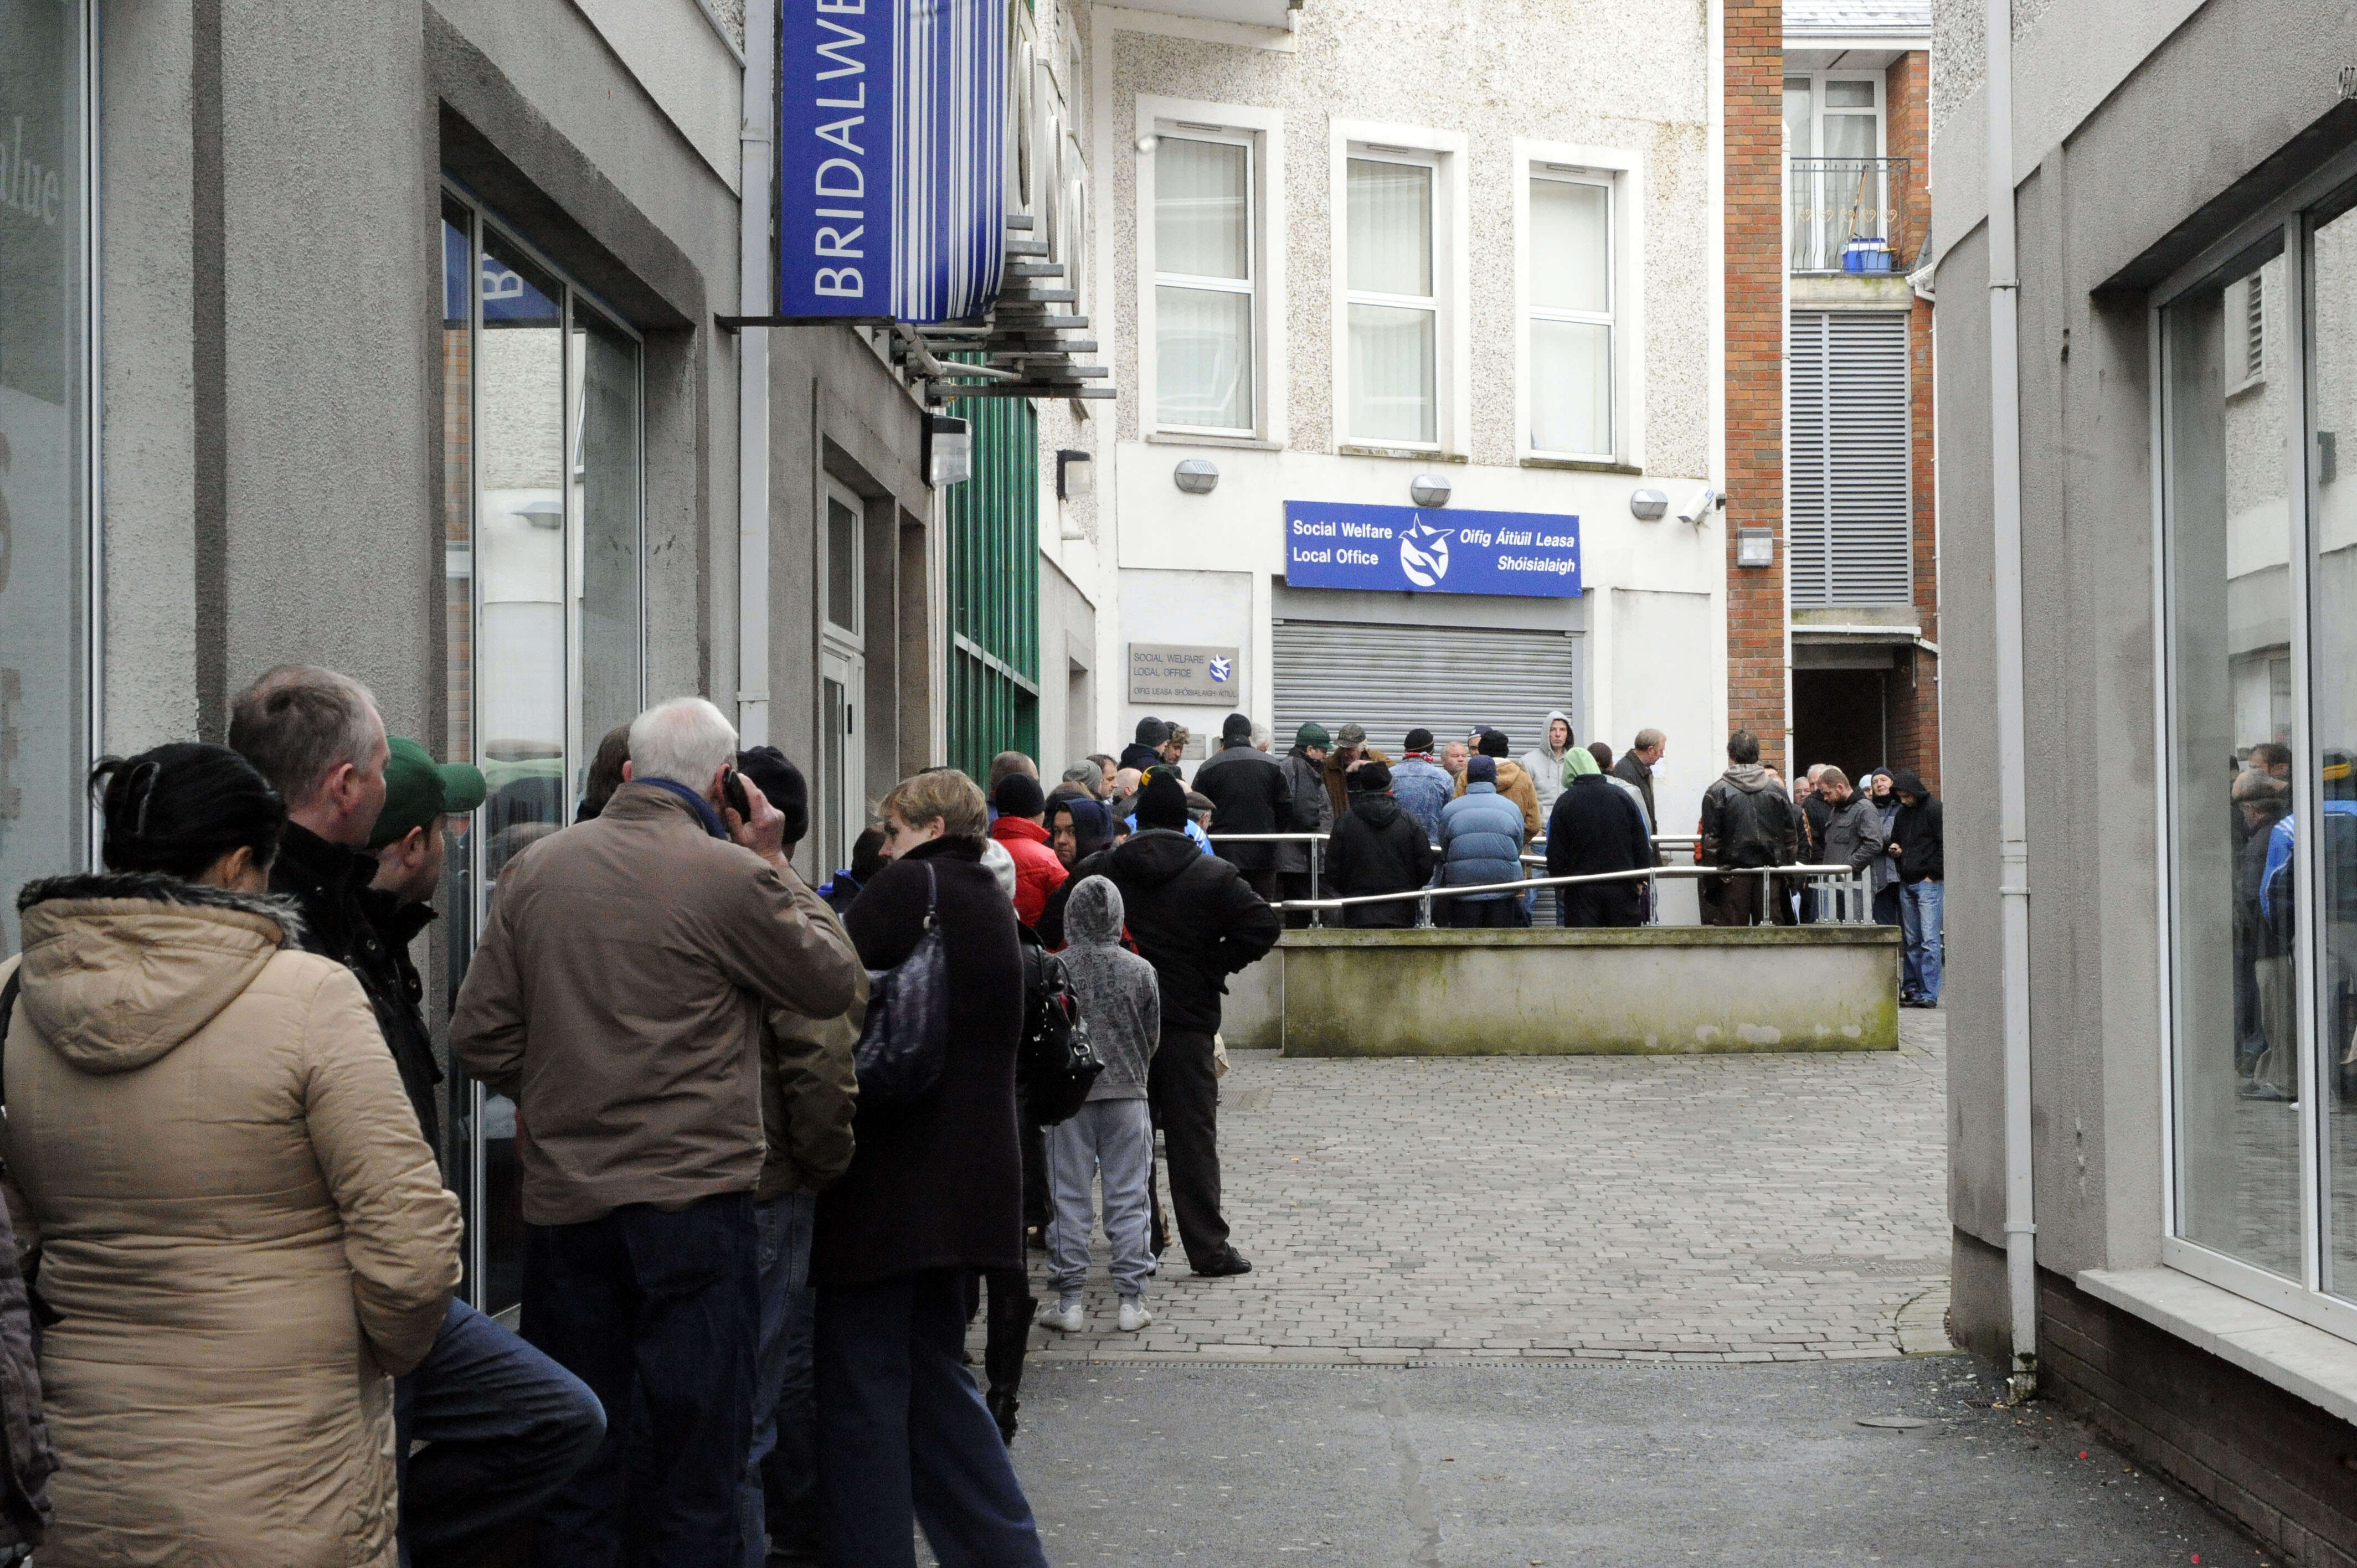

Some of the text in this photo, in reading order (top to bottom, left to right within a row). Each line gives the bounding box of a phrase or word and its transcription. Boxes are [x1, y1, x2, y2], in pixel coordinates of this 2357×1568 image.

[1293, 519, 1393, 539] Social Welfare
[1460, 527, 1575, 548] Oifig Áitiúil Leasa
[1293, 546, 1379, 565] Local Office
[1497, 555, 1576, 575] Shóisialaigh
[1134, 653, 1205, 664] SOCIAL WELFARE
[1134, 667, 1192, 678] LOCAL OFFICE
